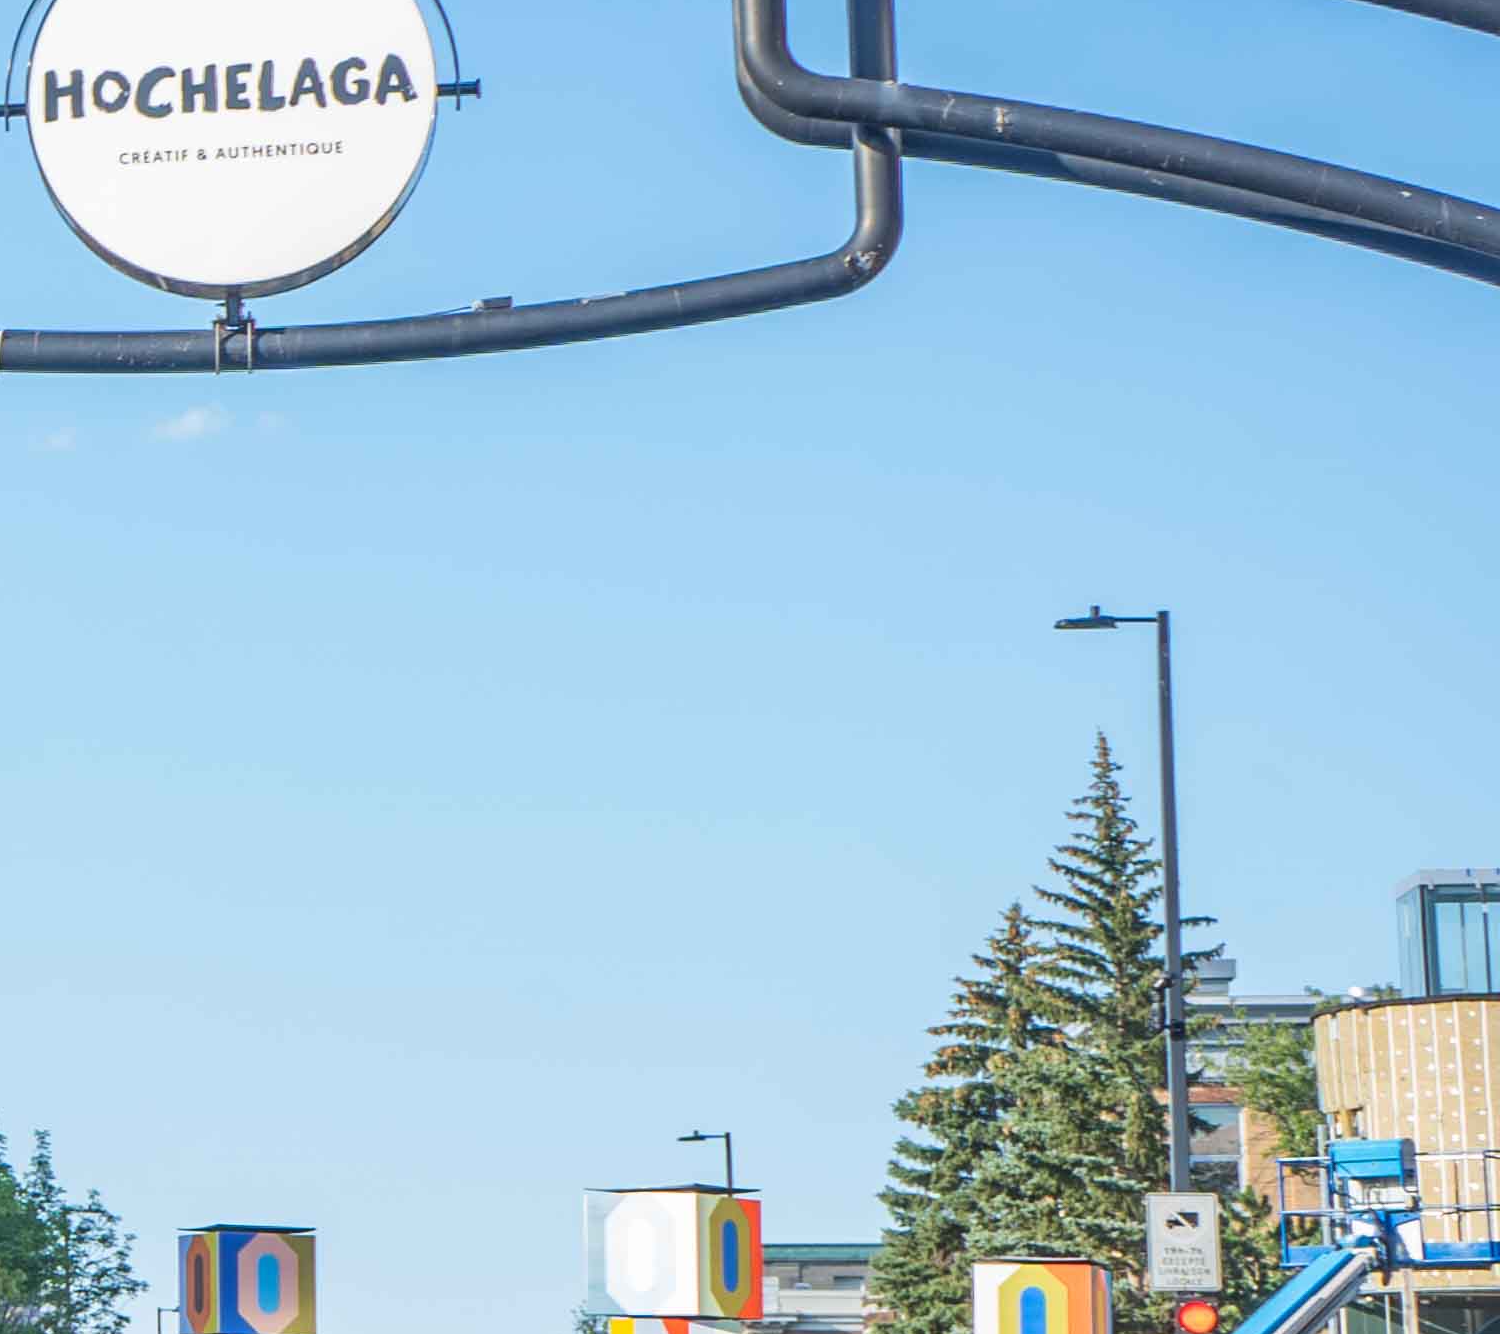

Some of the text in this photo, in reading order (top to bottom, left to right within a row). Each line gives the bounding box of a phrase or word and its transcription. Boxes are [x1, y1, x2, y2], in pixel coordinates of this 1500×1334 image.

[43, 53, 418, 123] HOCHELAGA
[196, 148, 208, 161] &
[215, 141, 344, 160] AUTHENTIQUE
